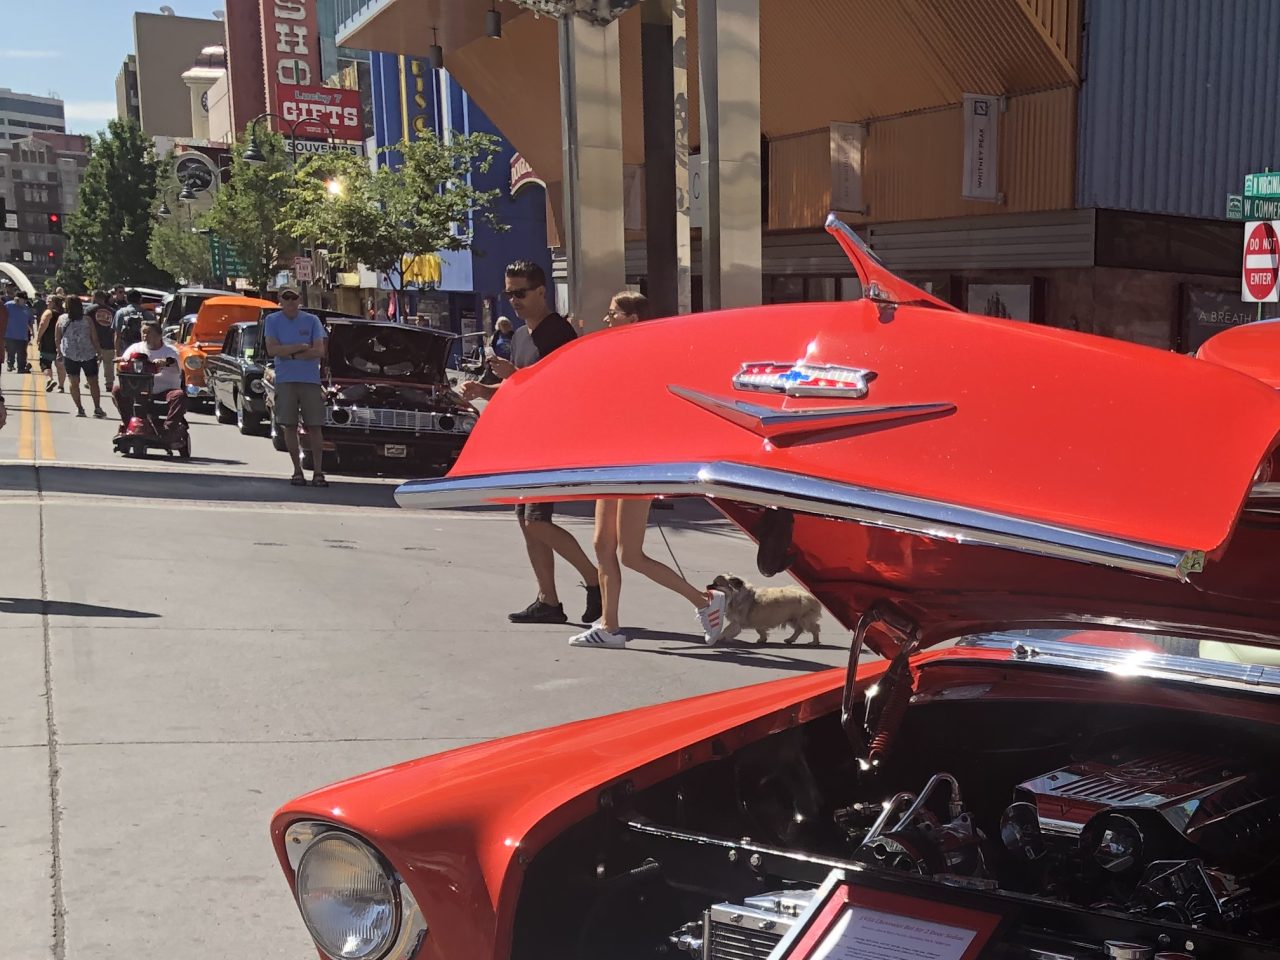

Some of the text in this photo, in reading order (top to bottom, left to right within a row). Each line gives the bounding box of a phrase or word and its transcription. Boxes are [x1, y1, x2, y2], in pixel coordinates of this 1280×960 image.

[283, 101, 358, 126] GIFTS
[1244, 199, 1251, 216] W
[1250, 238, 1277, 250] DO NOT
[1250, 272, 1271, 285] ENTER
[1211, 311, 1252, 323] BREATH
